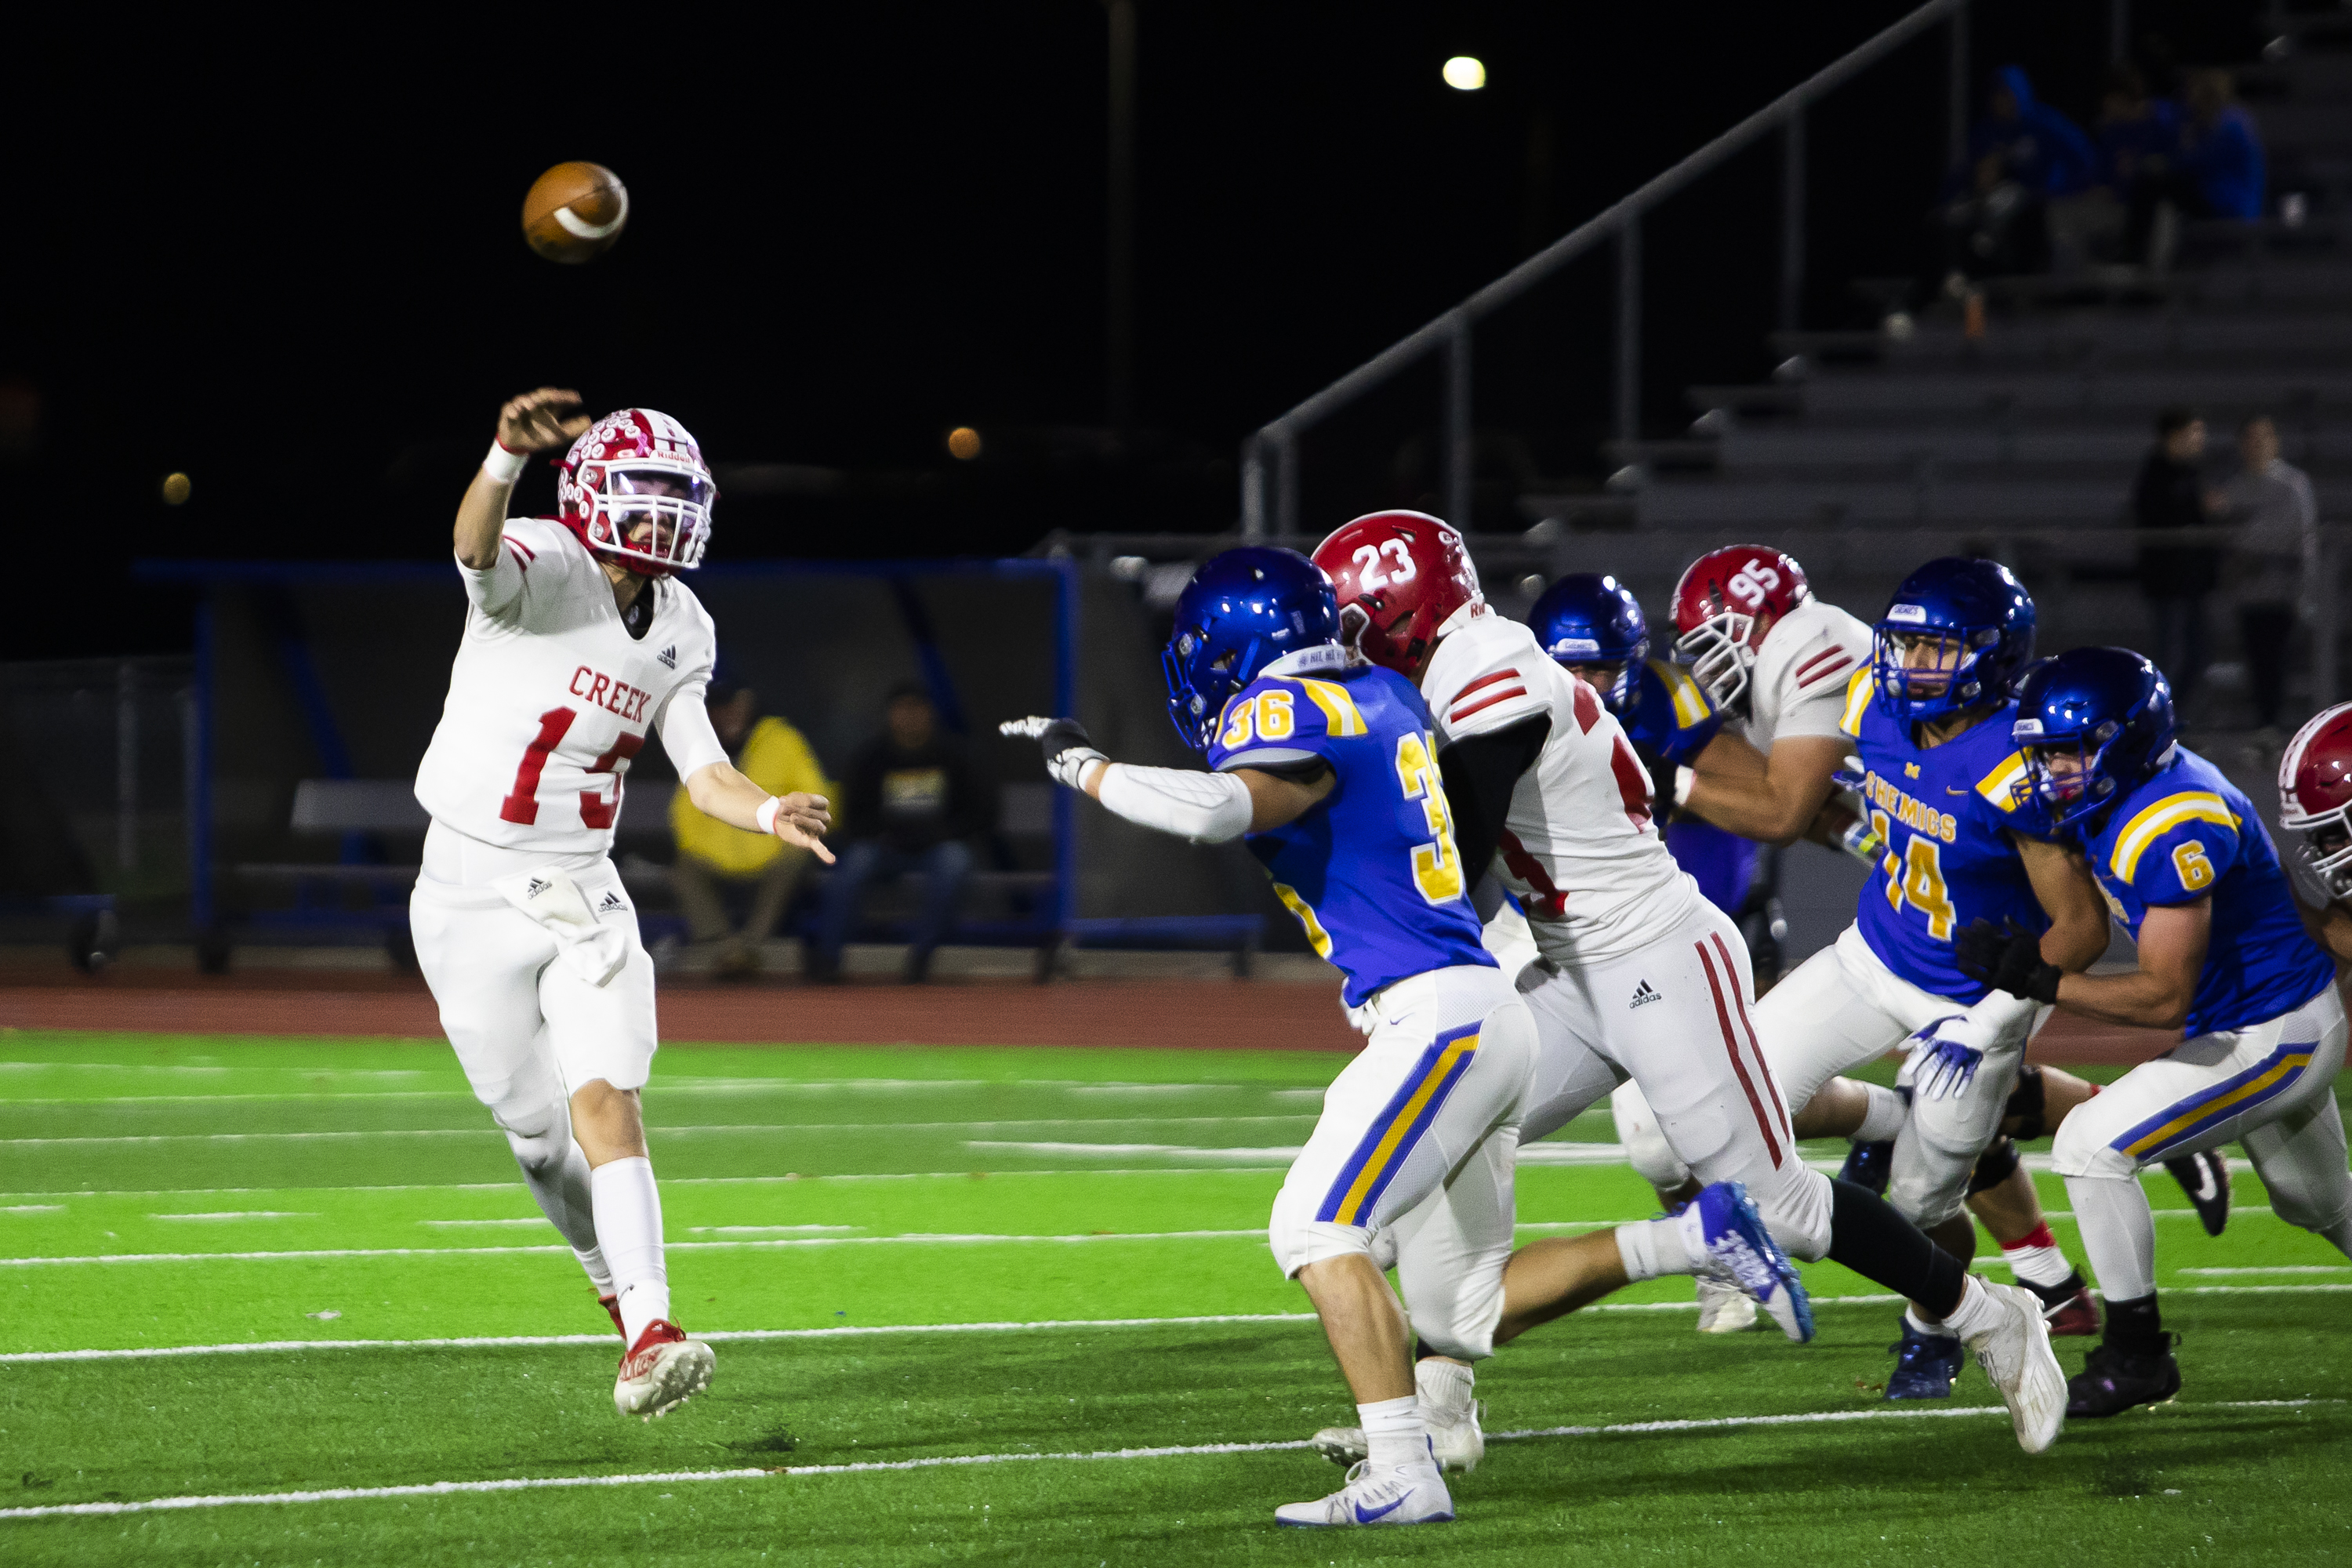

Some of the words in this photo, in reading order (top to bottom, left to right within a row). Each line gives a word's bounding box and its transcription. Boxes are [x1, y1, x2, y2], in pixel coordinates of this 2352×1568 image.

[1352, 538, 1417, 591] 23
[1727, 557, 1780, 608] 95
[568, 665, 652, 724] CREEK
[1222, 689, 1294, 750] 36
[527, 880, 553, 900] adidas
[1871, 809, 1958, 942] 14
[2171, 839, 2216, 891] 6
[1628, 993, 1662, 1009] adidas
